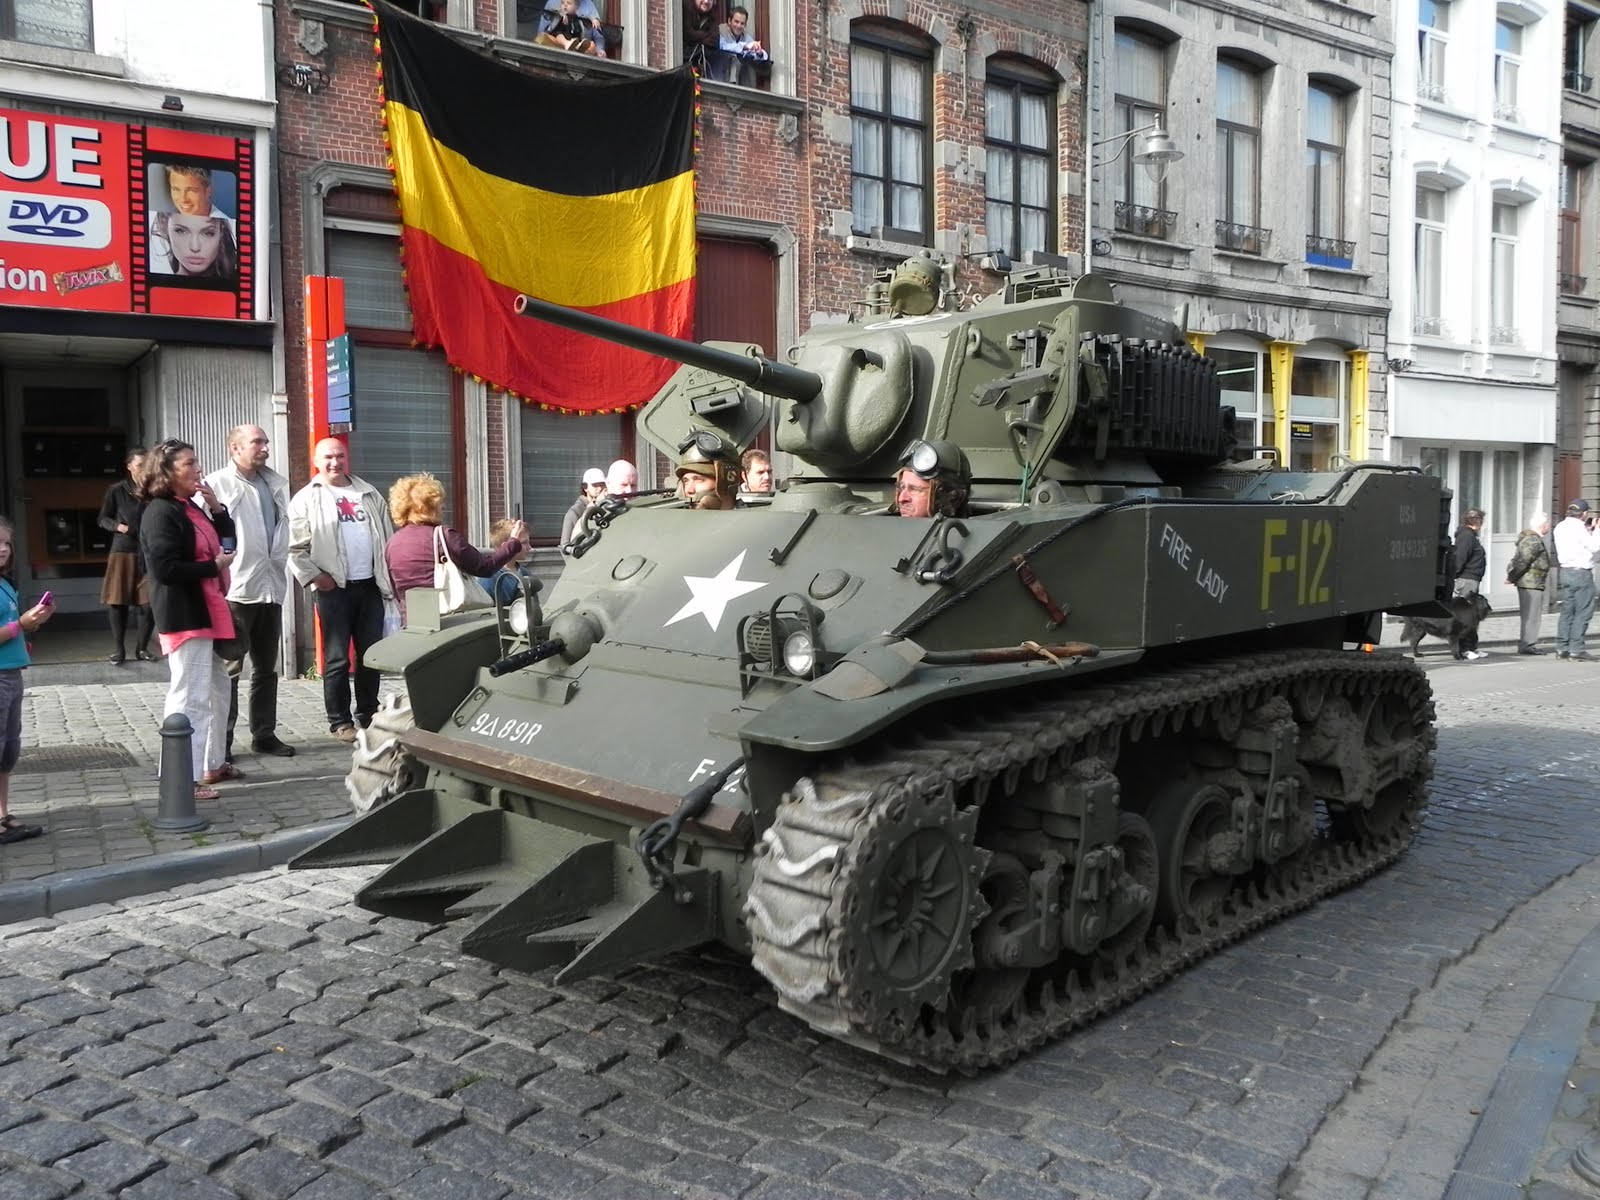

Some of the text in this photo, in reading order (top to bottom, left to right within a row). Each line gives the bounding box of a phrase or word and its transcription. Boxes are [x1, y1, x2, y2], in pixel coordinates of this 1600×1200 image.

[9, 200, 89, 225] DVD
[1400, 504, 1416, 523] USA
[1160, 523, 1229, 603] FIRE LADY
[1260, 519, 1332, 610] F-12
